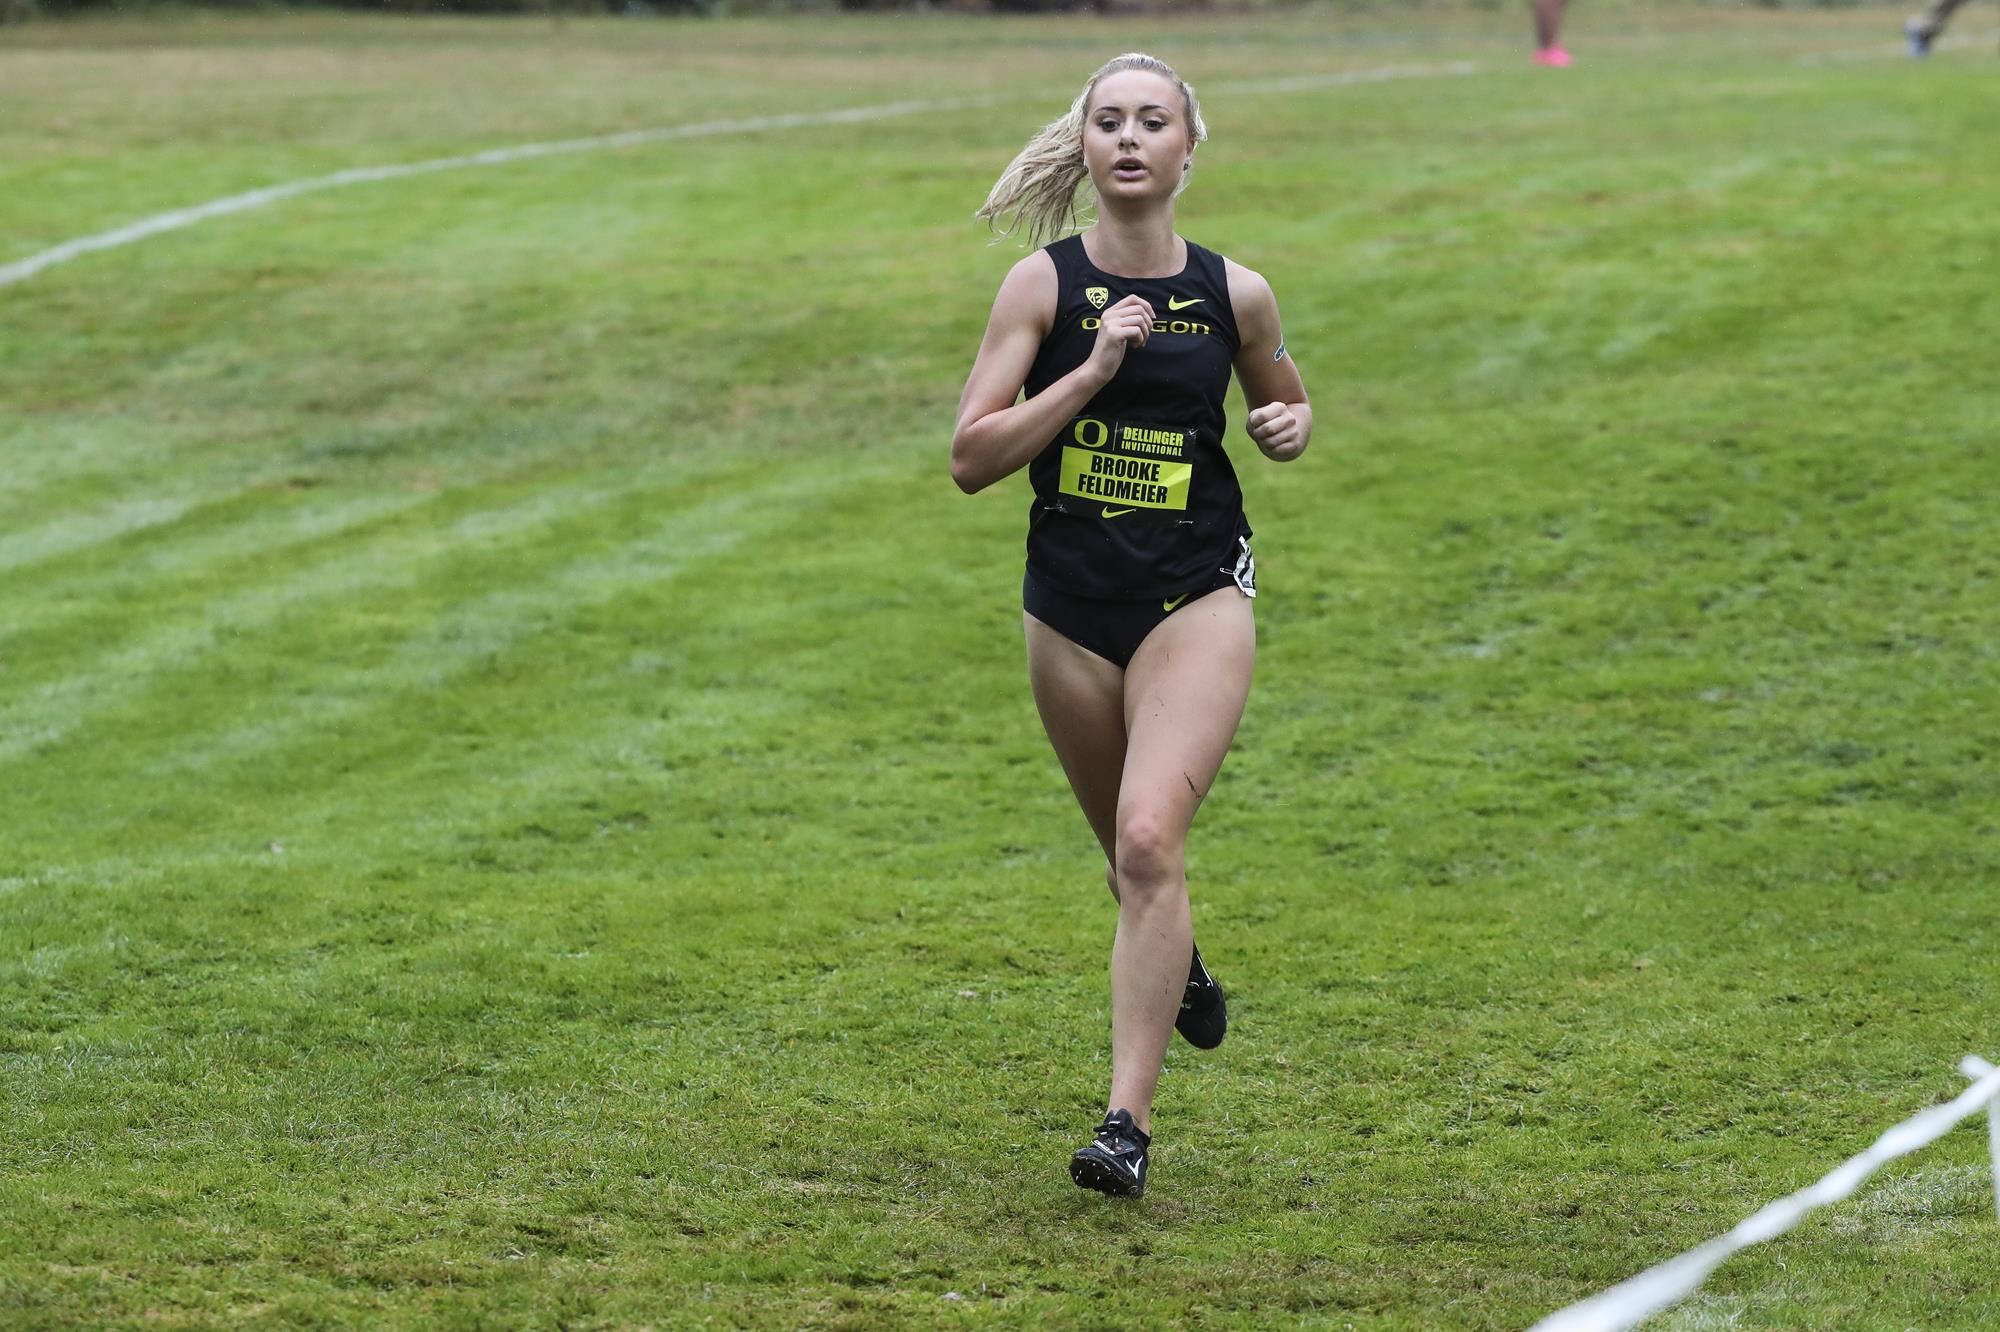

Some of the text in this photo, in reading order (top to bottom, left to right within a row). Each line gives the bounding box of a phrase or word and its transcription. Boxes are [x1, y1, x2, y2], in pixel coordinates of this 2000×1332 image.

[1081, 317, 1210, 335] OGON
[1074, 419, 1109, 448] O
[1122, 426, 1184, 447] DELLINGER
[1121, 441, 1183, 457] INVITATIONAL
[1091, 454, 1161, 482] BROOKE
[1077, 473, 1169, 504] FELDMEIER
